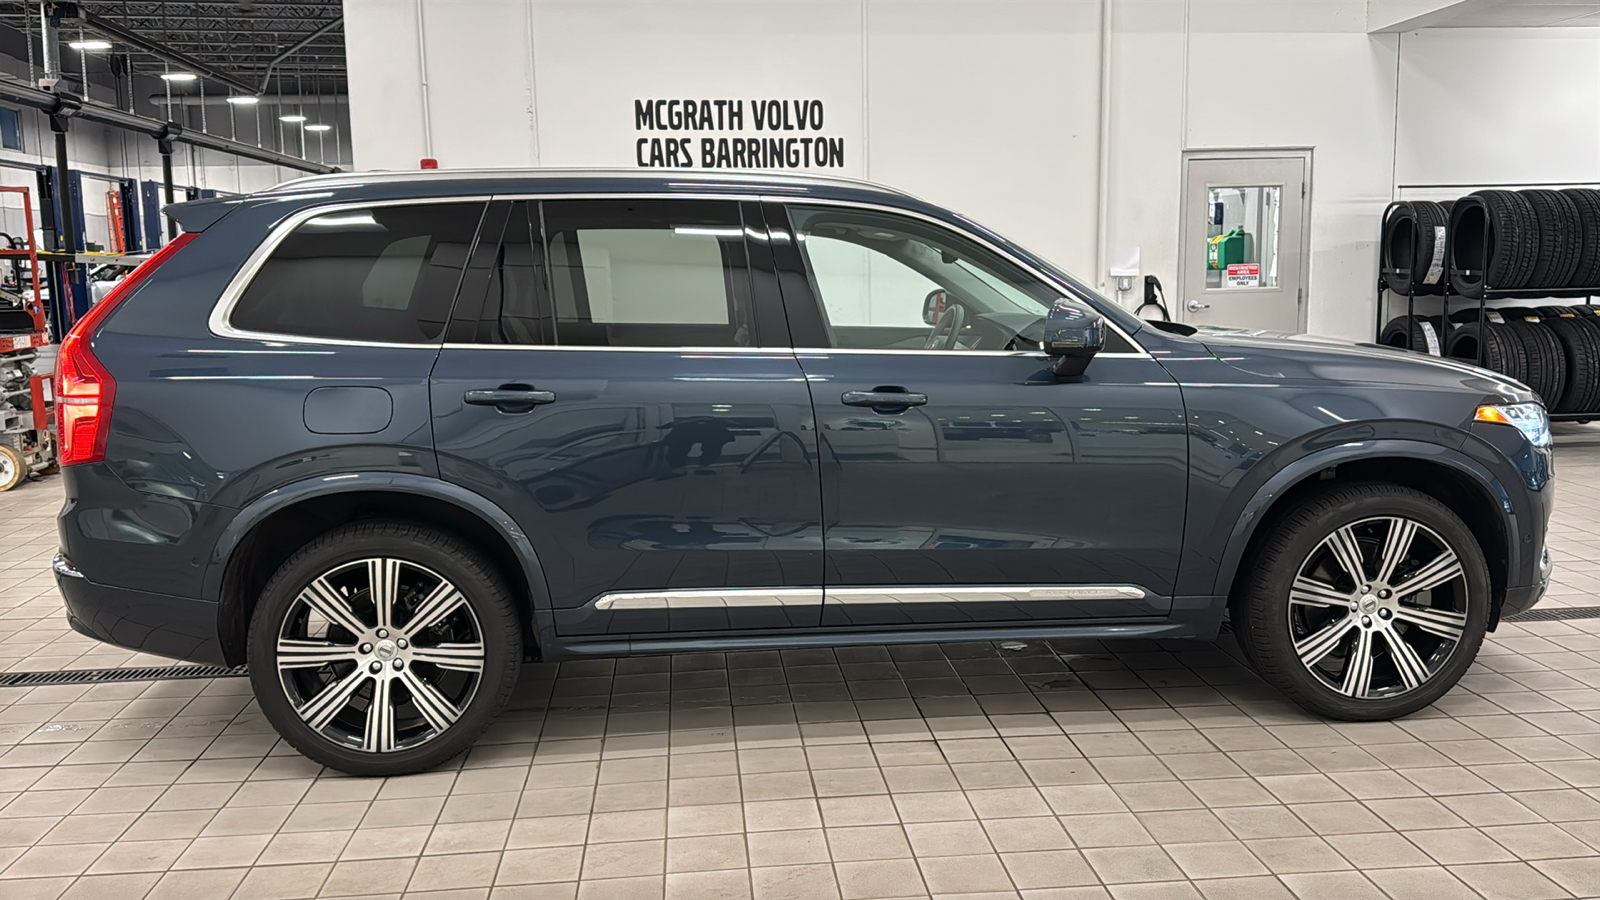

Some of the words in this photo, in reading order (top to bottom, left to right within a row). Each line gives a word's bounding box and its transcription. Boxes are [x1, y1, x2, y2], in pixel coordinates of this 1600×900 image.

[635, 99, 743, 131] MCGRATH
[751, 99, 824, 131] VOLVO
[636, 137, 693, 168] CARS
[701, 136, 844, 168] BARRINGTON
